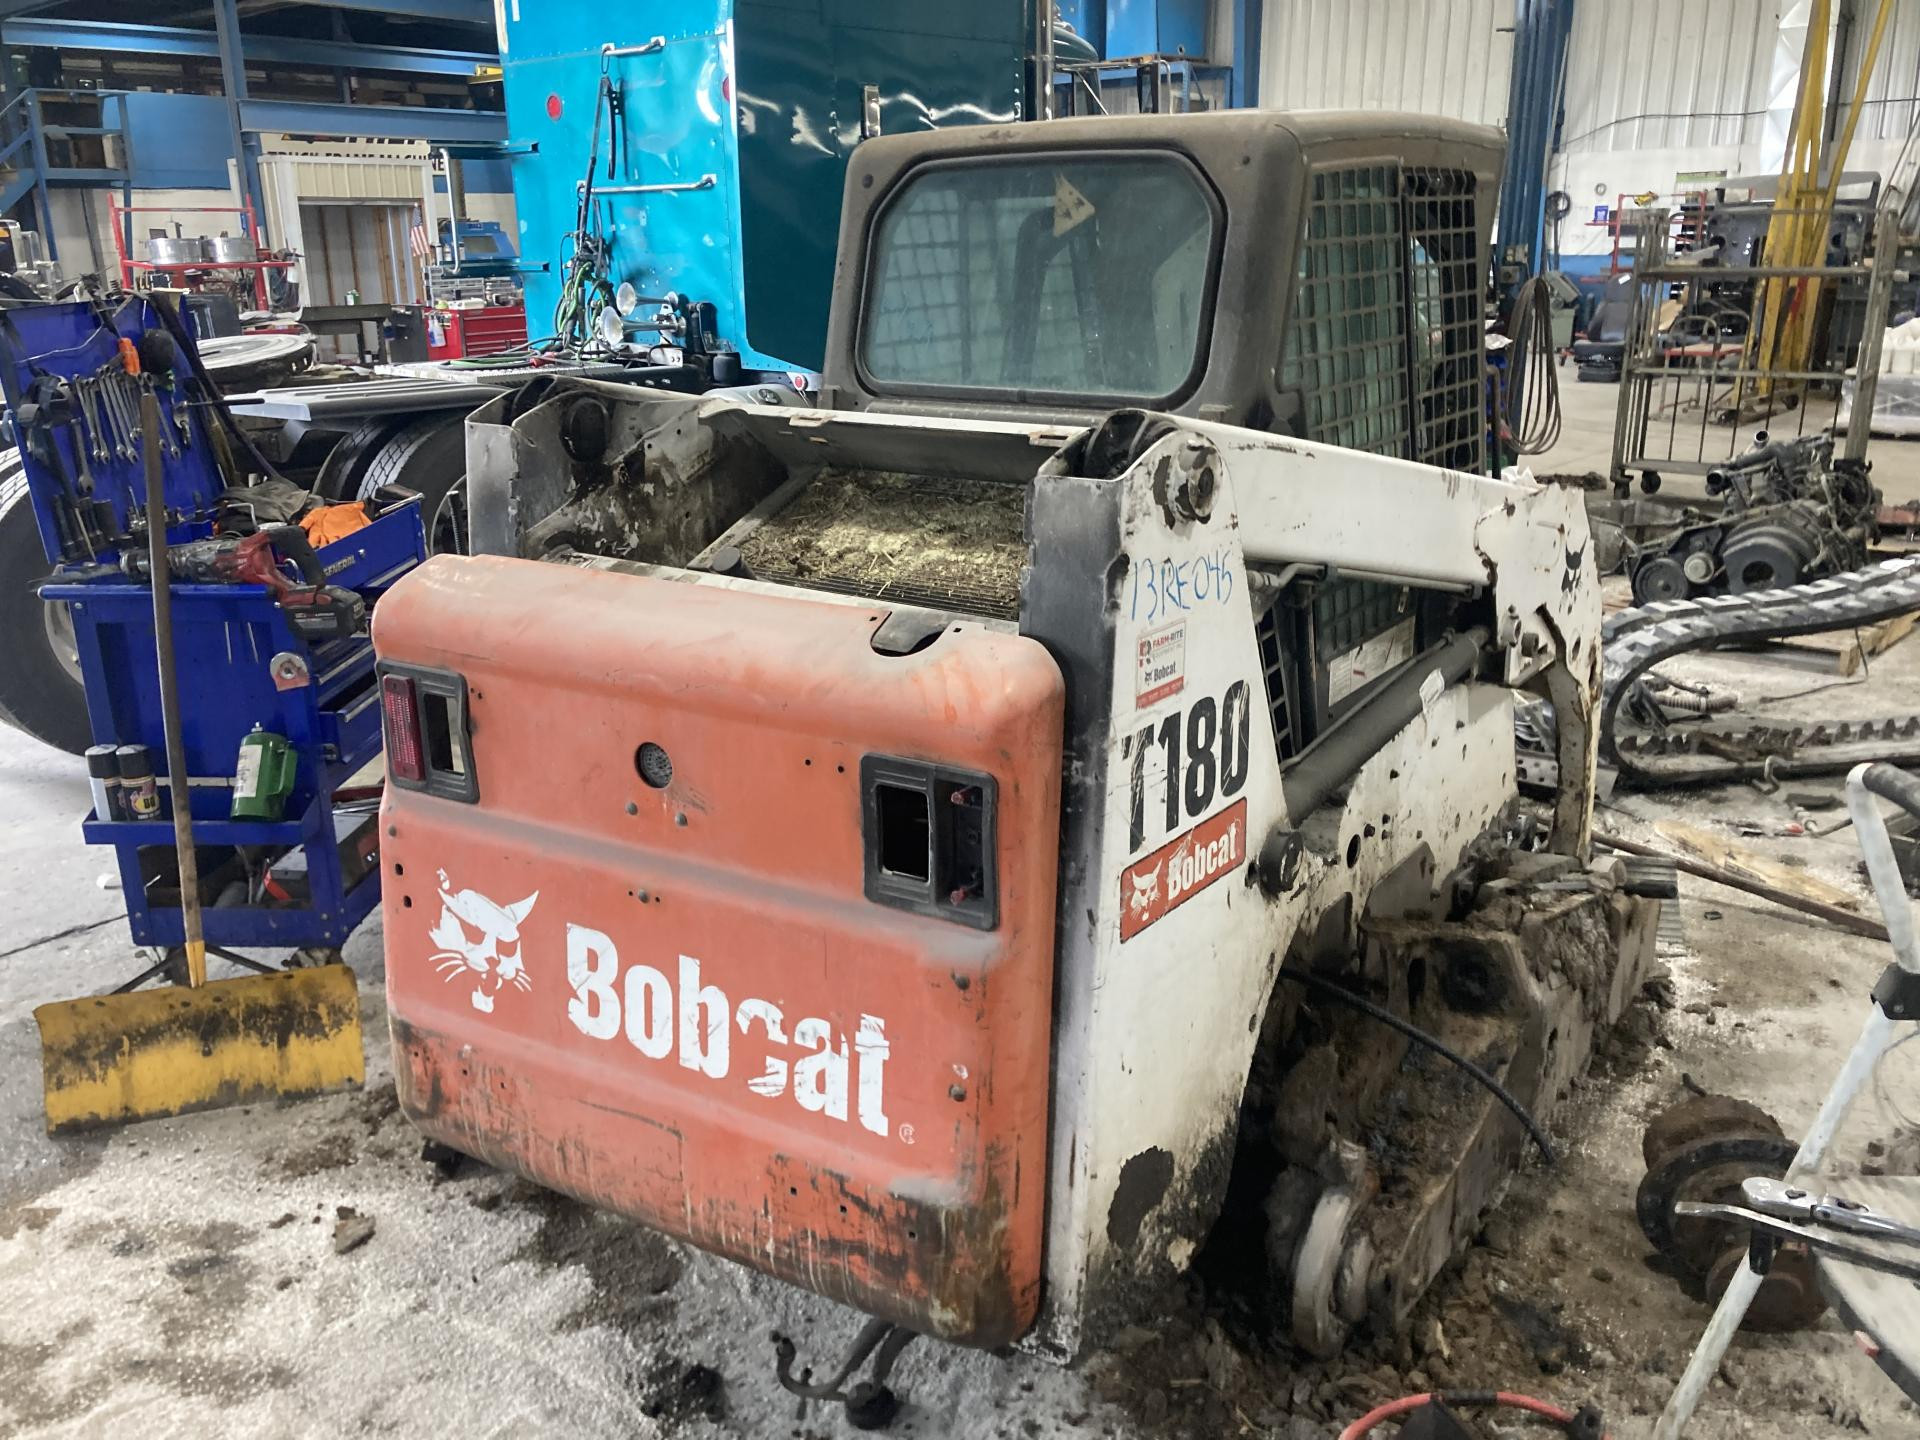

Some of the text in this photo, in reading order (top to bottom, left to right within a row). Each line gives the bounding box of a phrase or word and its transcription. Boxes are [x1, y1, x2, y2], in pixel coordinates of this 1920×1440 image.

[1154, 661, 1176, 682] Bobcat
[1121, 680, 1250, 854] T180
[1167, 820, 1237, 901] Bobcat
[567, 922, 889, 1137] Bobcat
